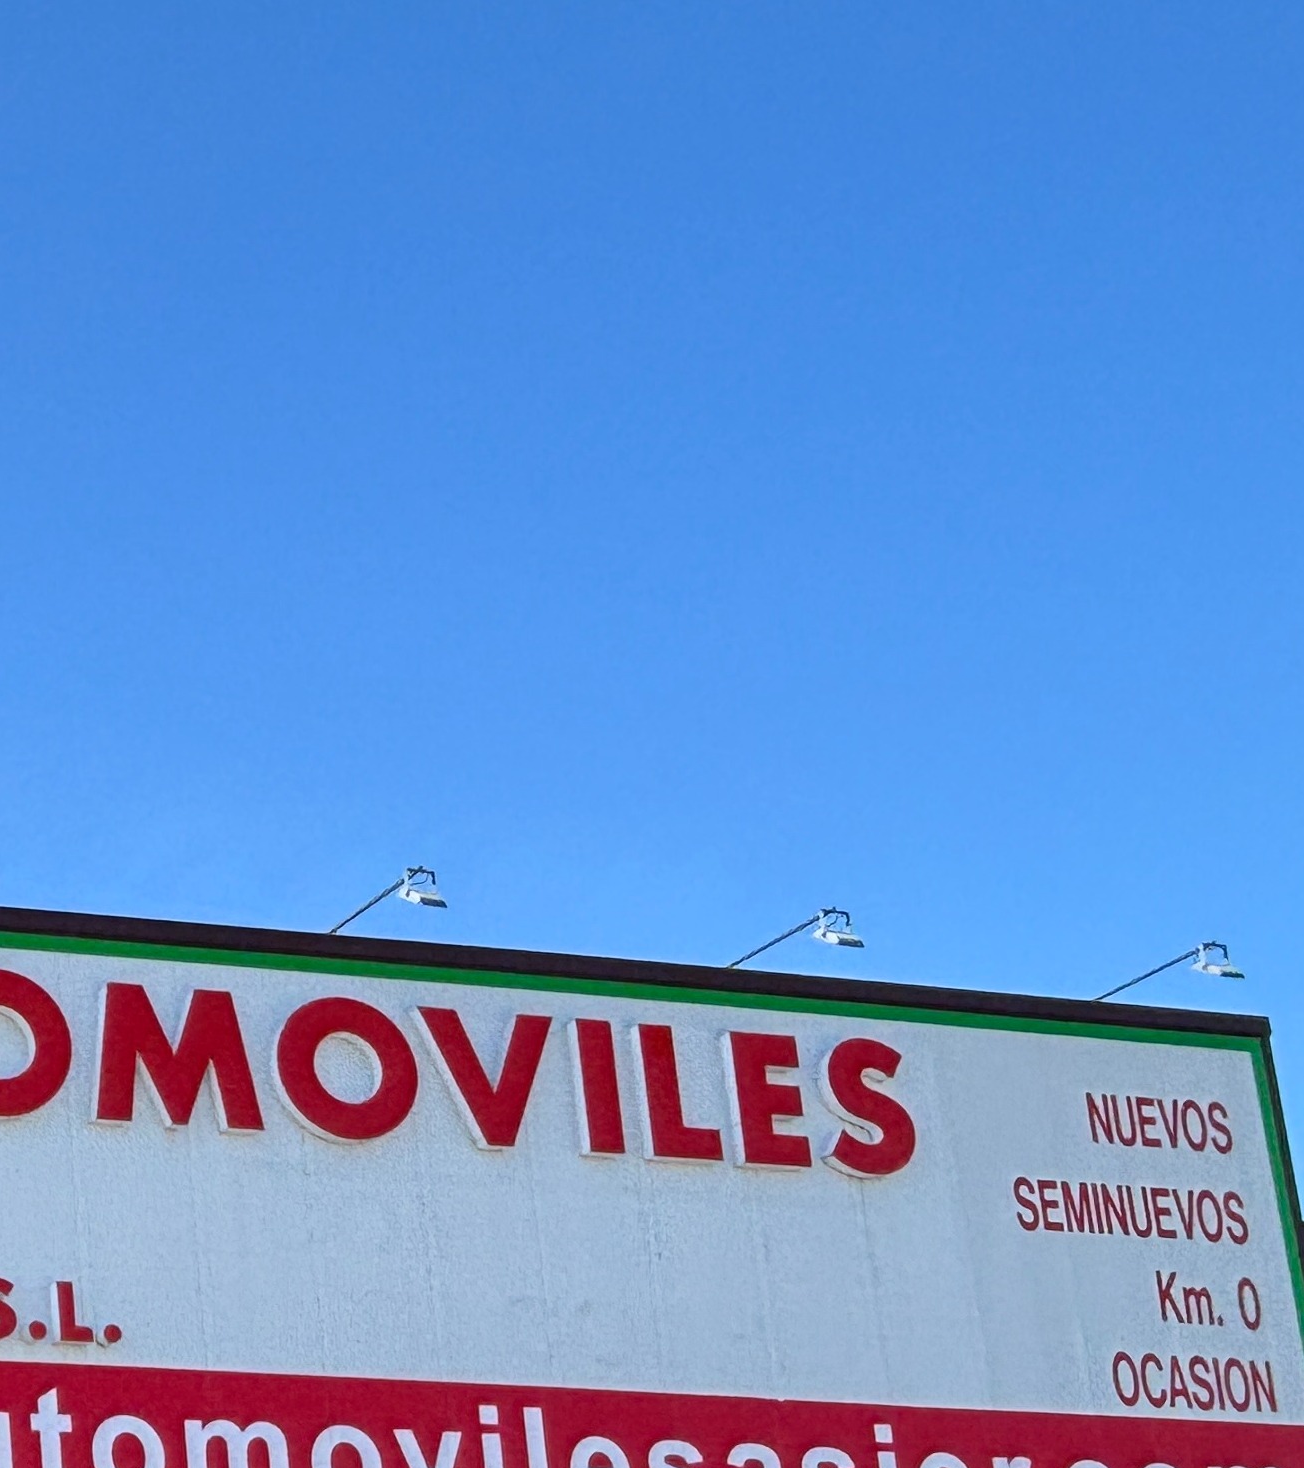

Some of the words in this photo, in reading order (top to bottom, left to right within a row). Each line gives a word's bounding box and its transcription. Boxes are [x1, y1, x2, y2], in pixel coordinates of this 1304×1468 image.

[1085, 1092, 1233, 1155] NUEVOS
[1012, 1176, 1249, 1246] SEMINUEVOS
[1157, 1270, 1226, 1326] Km.
[1238, 1276, 1263, 1332] 0
[1113, 1350, 1278, 1411] OCASION
